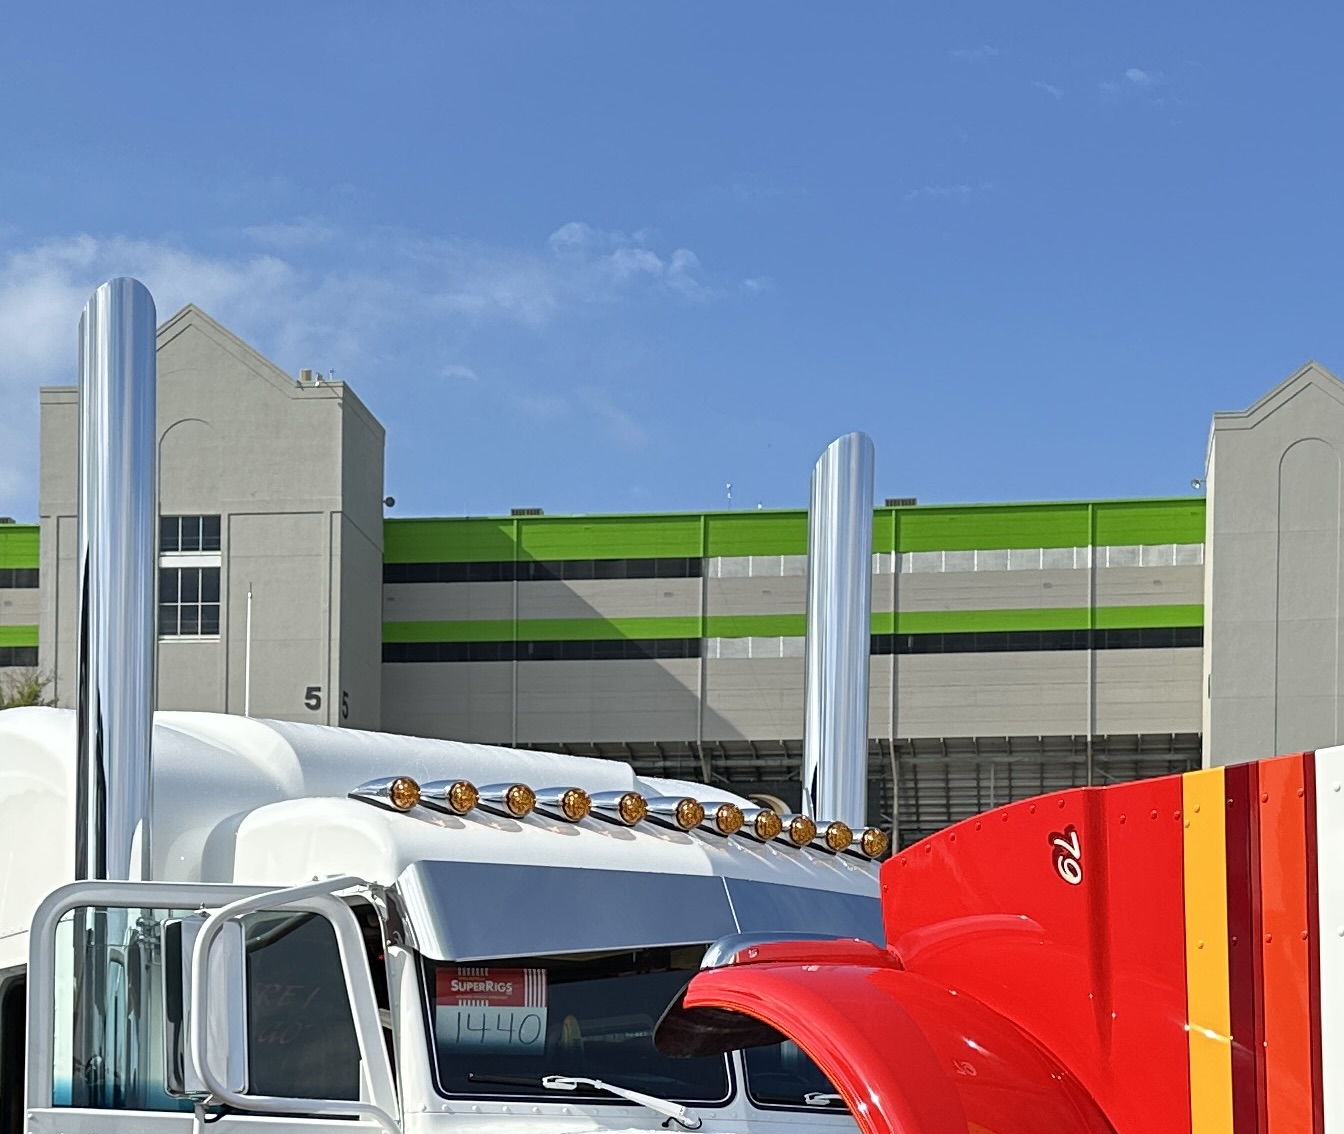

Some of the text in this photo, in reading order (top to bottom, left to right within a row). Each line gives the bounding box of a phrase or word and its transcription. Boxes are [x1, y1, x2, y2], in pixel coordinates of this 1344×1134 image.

[304, 686, 322, 711] 5
[341, 691, 349, 719] 5
[1053, 830, 1082, 885] 79
[456, 1011, 542, 1045] 1440
